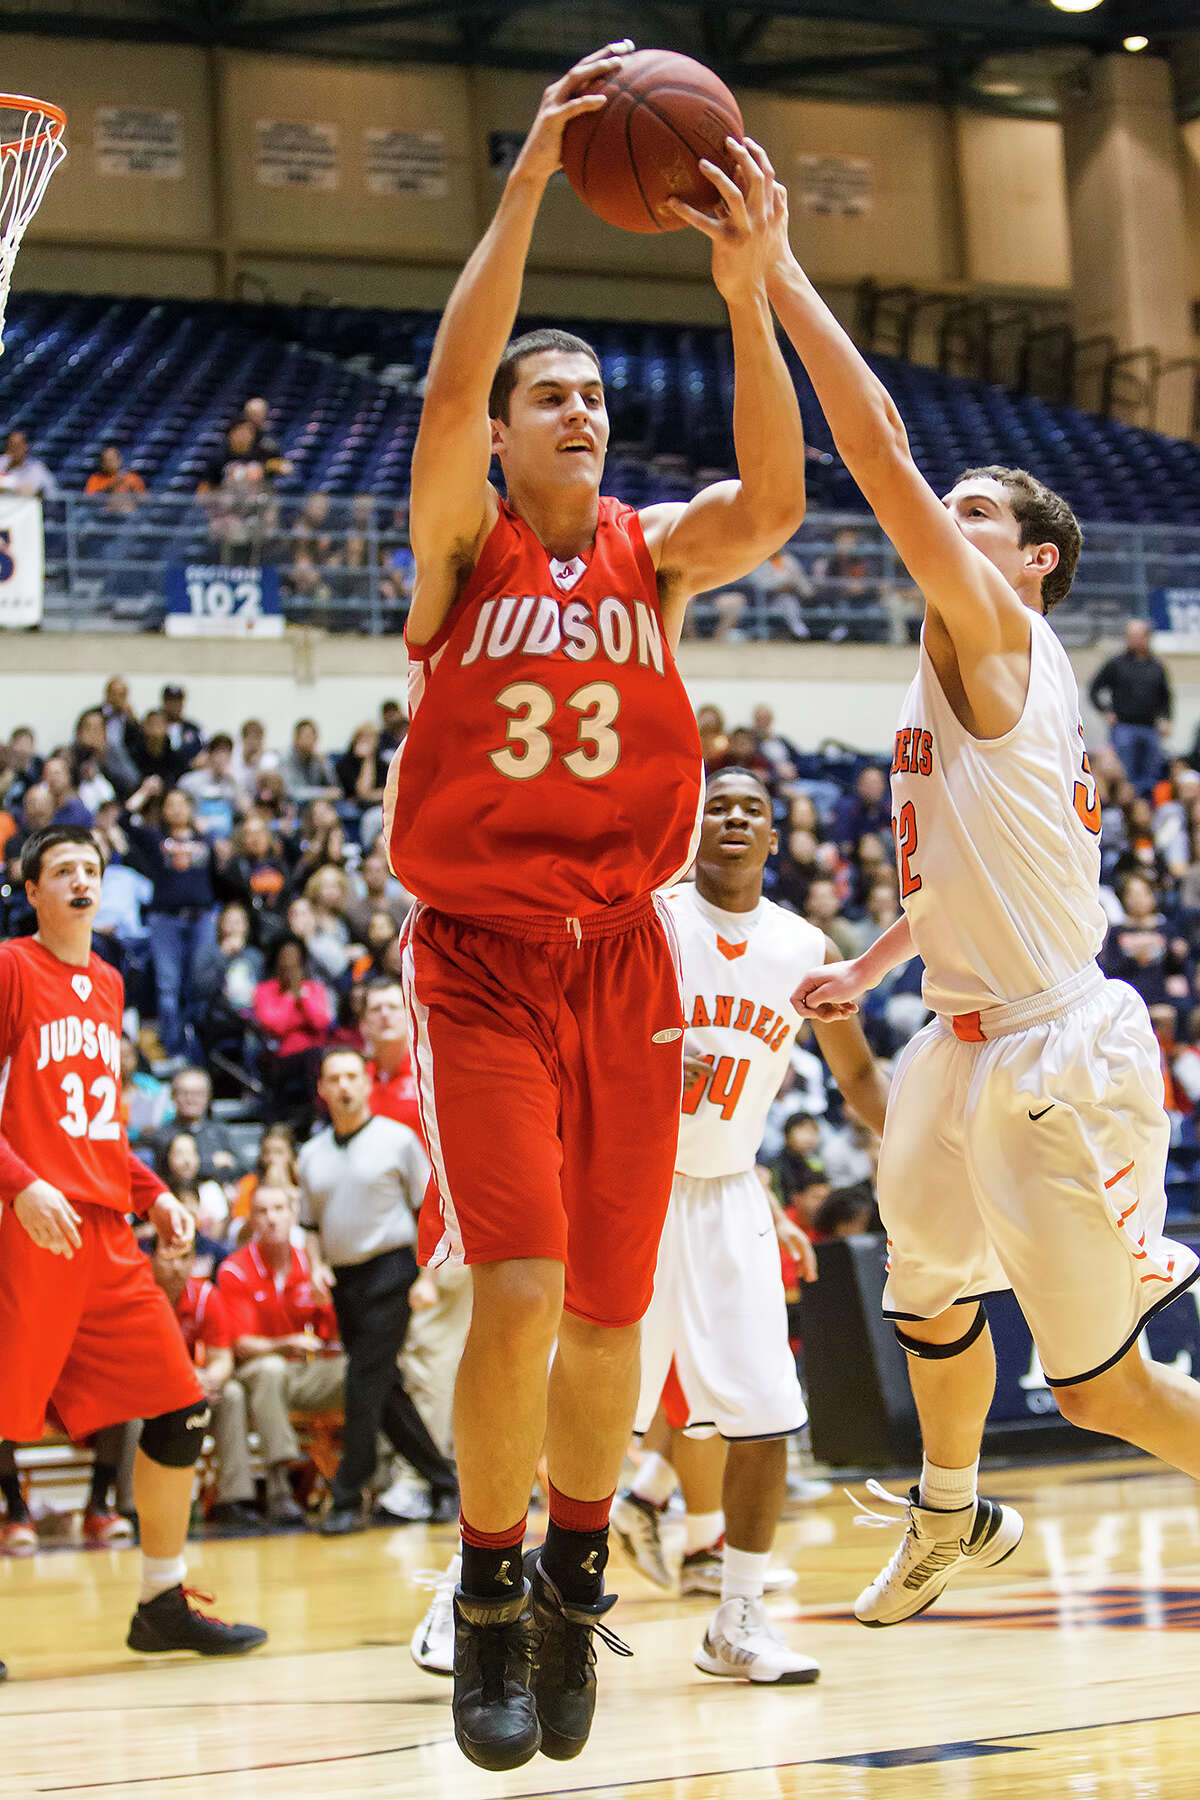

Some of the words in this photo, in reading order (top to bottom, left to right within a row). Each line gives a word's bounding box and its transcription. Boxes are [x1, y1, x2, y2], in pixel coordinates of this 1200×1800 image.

[187, 582, 262, 617] 102
[460, 595, 665, 678] JUDSON
[487, 680, 622, 781] 33
[36, 1015, 121, 1081] JUDSON
[683, 994, 791, 1053] ANDEIS
[58, 1071, 120, 1141] 32
